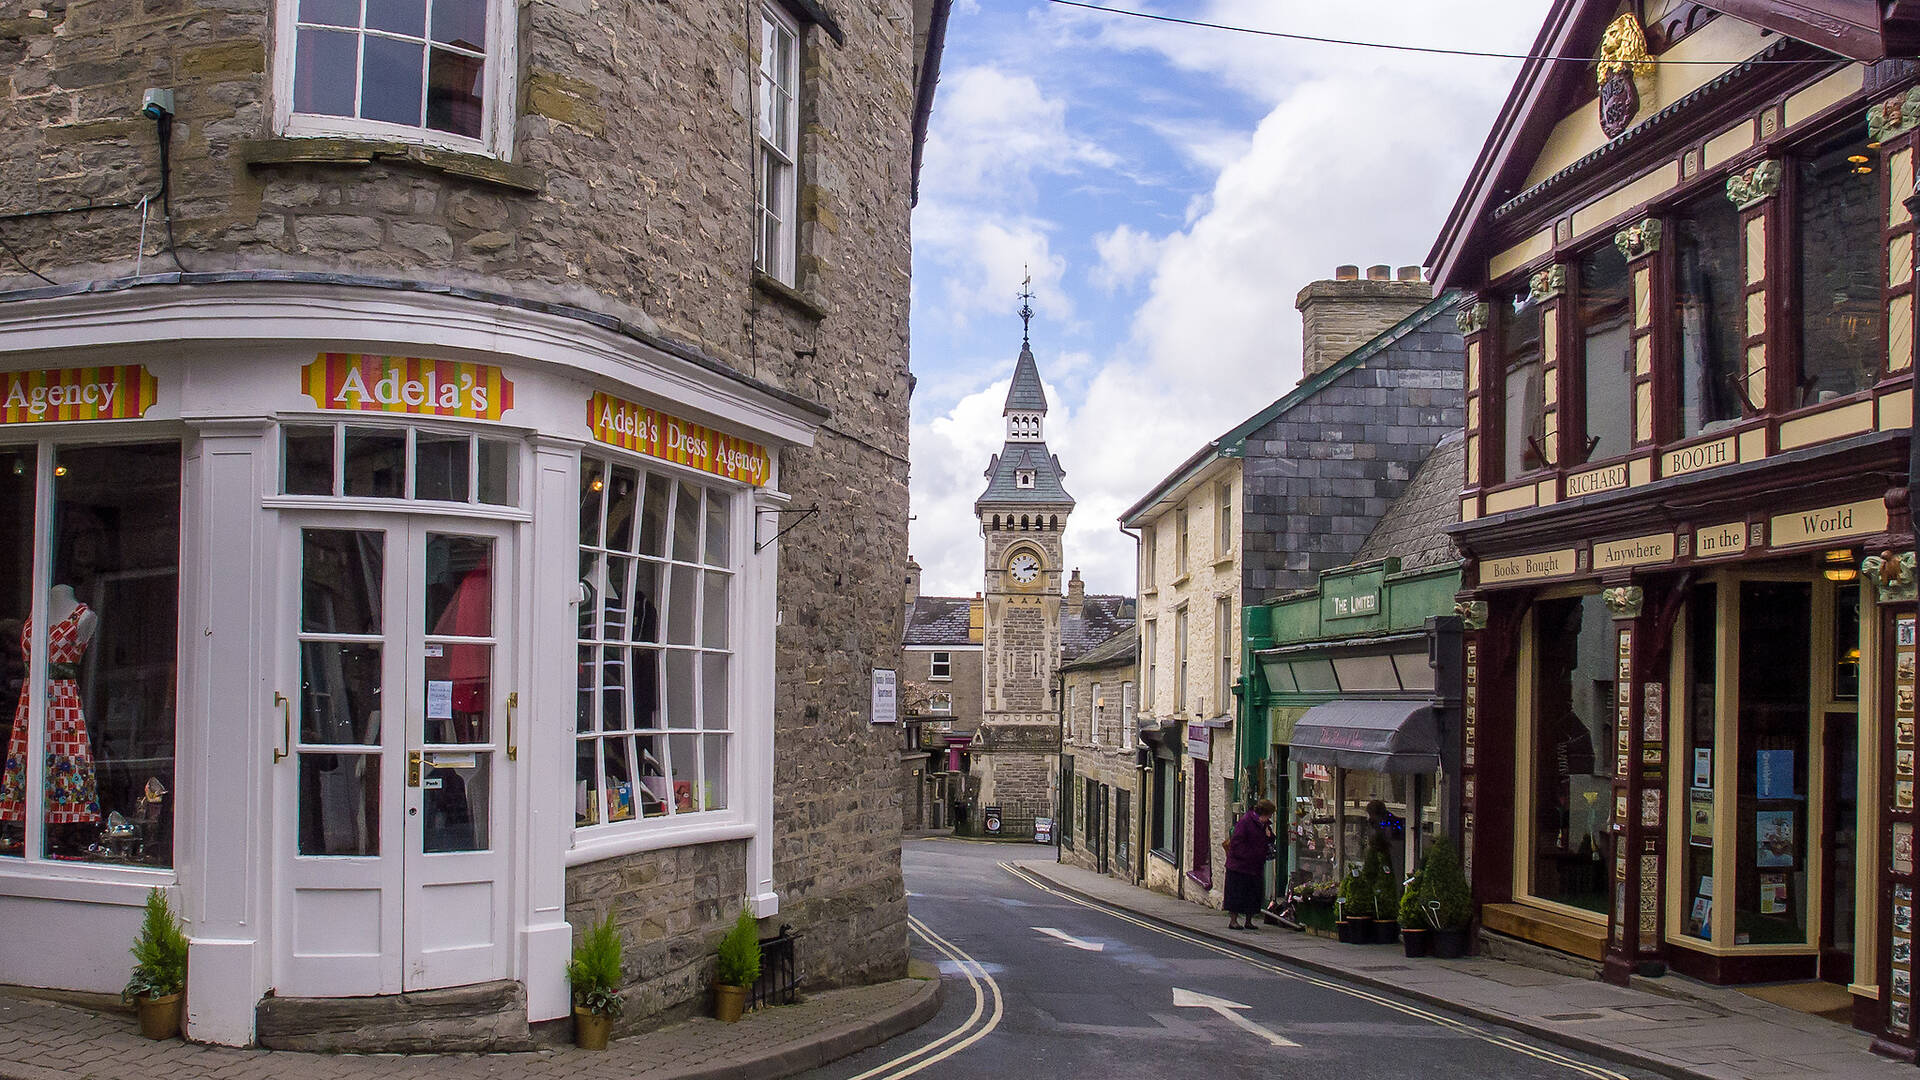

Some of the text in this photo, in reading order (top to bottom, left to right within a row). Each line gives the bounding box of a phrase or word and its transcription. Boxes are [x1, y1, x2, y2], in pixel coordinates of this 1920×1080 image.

[2, 379, 119, 415] Agency
[333, 366, 489, 412] Adela's
[599, 402, 764, 480] Adela's Dress Agency
[1569, 441, 1727, 496] RICHARD BOOTH
[1493, 508, 1854, 578] Books Bought Anywhere in the World
